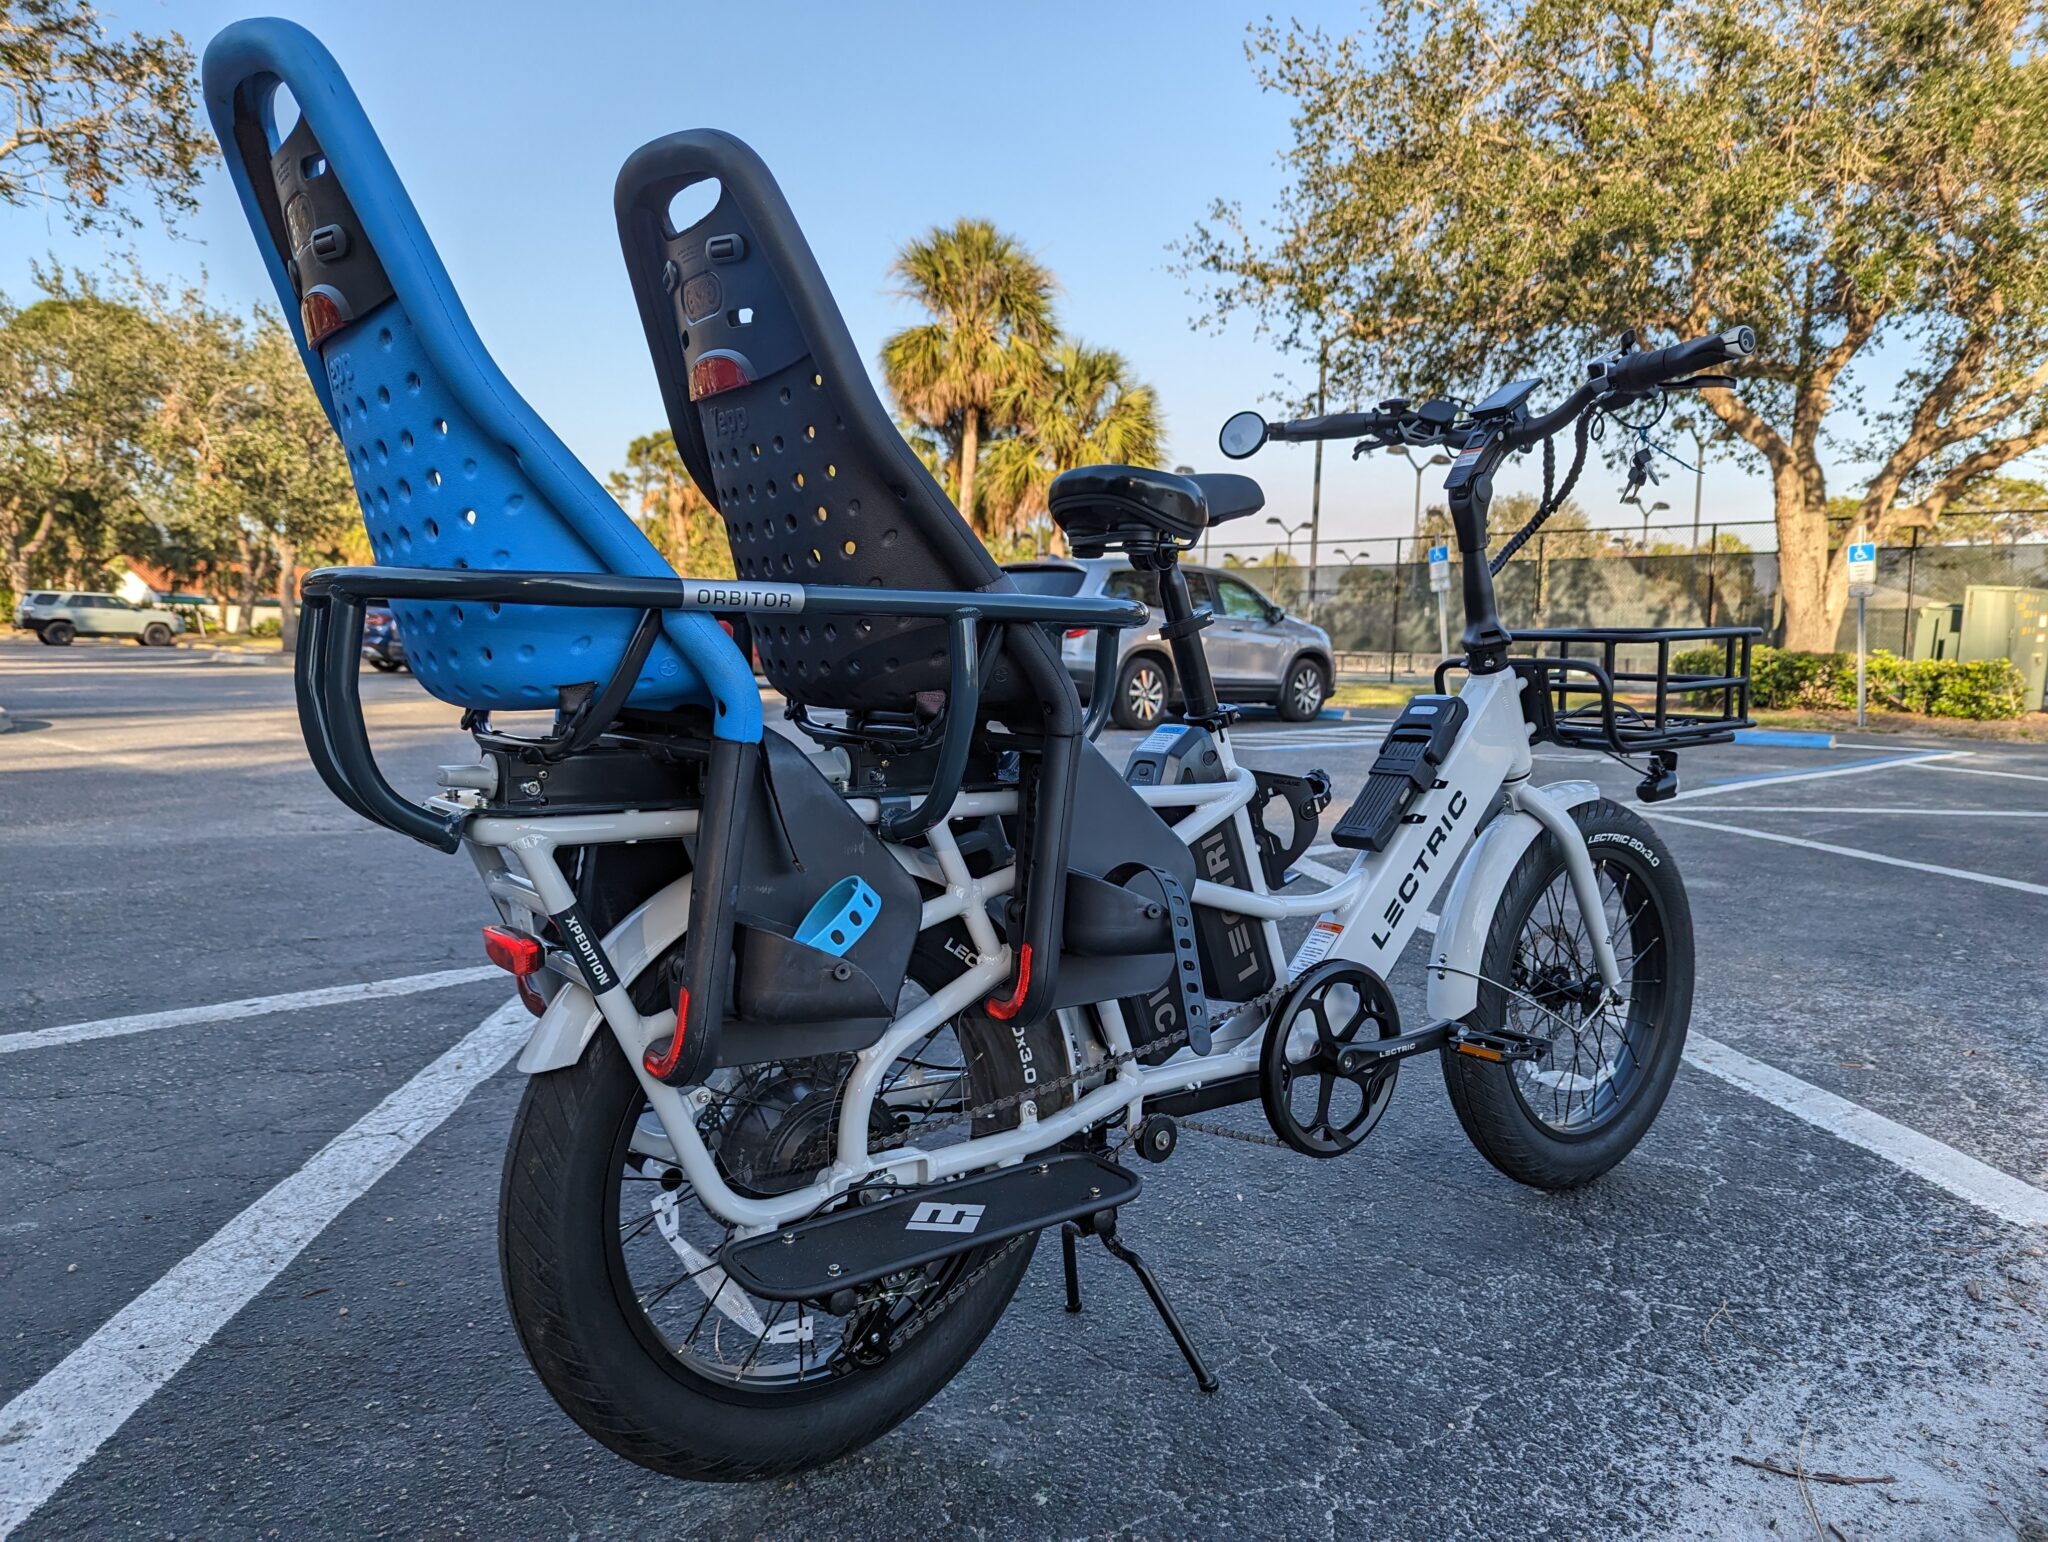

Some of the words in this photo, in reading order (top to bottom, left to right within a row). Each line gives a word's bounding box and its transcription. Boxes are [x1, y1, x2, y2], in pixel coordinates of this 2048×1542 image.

[697, 588, 792, 608] ORBITOR
[1587, 832, 1630, 844] LECTRIC
[1628, 838, 1660, 868] 20x3.0
[1371, 789, 1468, 951] LECTRIC
[564, 915, 611, 986] XPEDITION
[1379, 1042, 1416, 1058] LECTRIC
